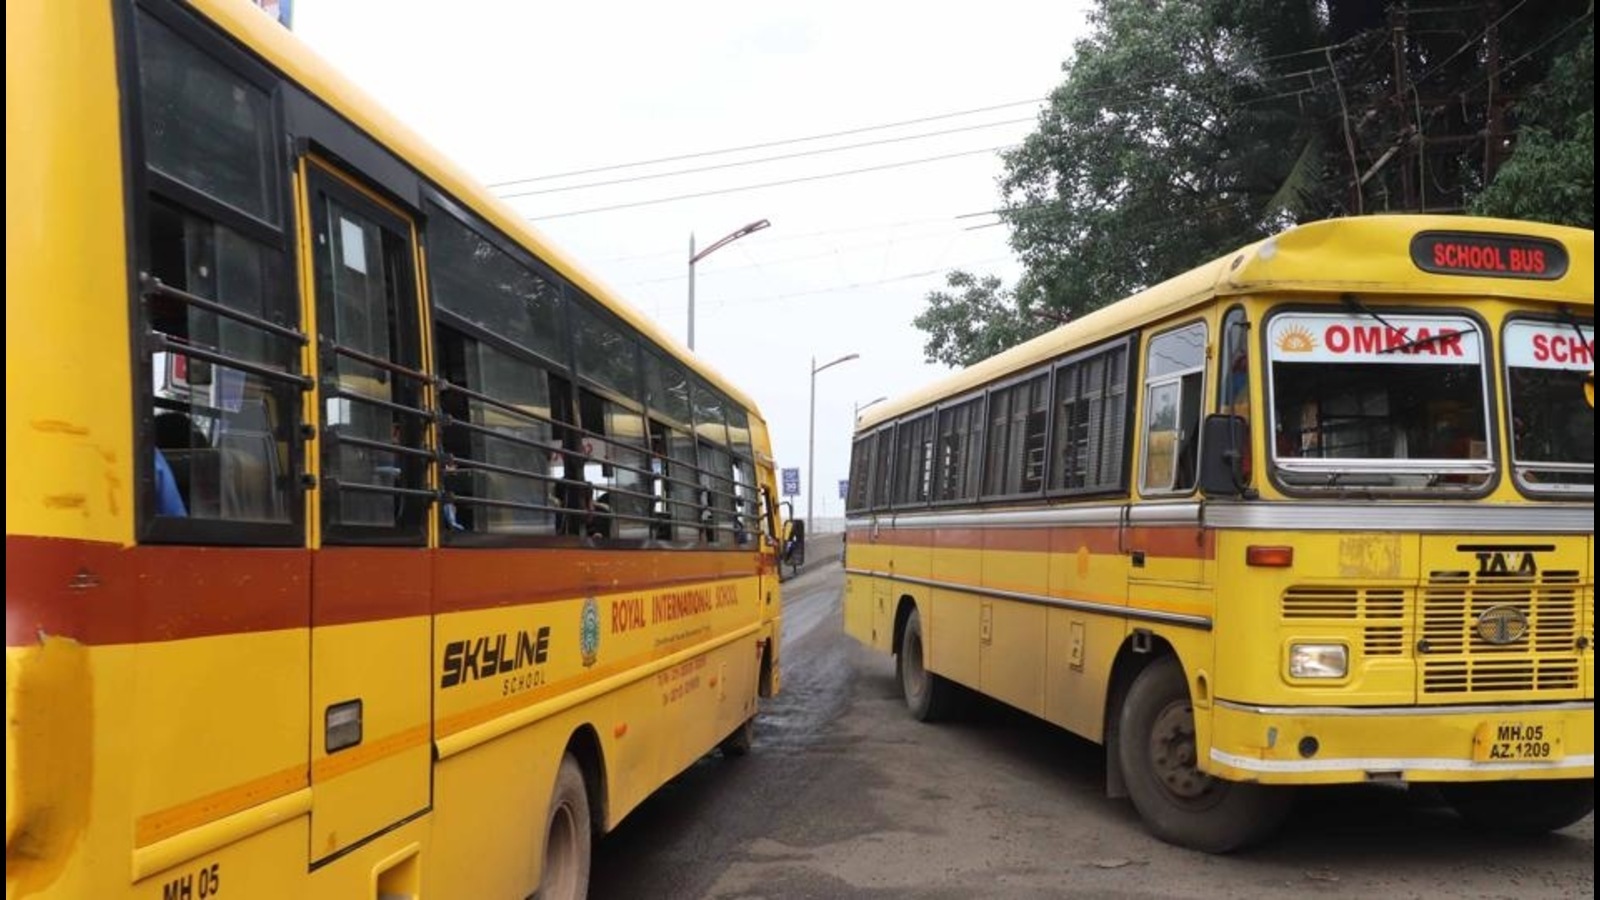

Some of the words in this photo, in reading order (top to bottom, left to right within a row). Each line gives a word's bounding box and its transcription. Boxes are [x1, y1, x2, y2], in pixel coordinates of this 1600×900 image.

[1433, 243, 1505, 270] SCHOOL
[1509, 248, 1545, 272] BUS
[1324, 324, 1463, 356] OMKAR
[1533, 334, 1594, 364] SCH
[611, 599, 646, 634] ROYAL
[652, 590, 712, 624] INTERNATIONAL
[440, 626, 550, 689] SKYLINE
[502, 671, 545, 696] SCHOOL
[198, 863, 219, 899] 05
